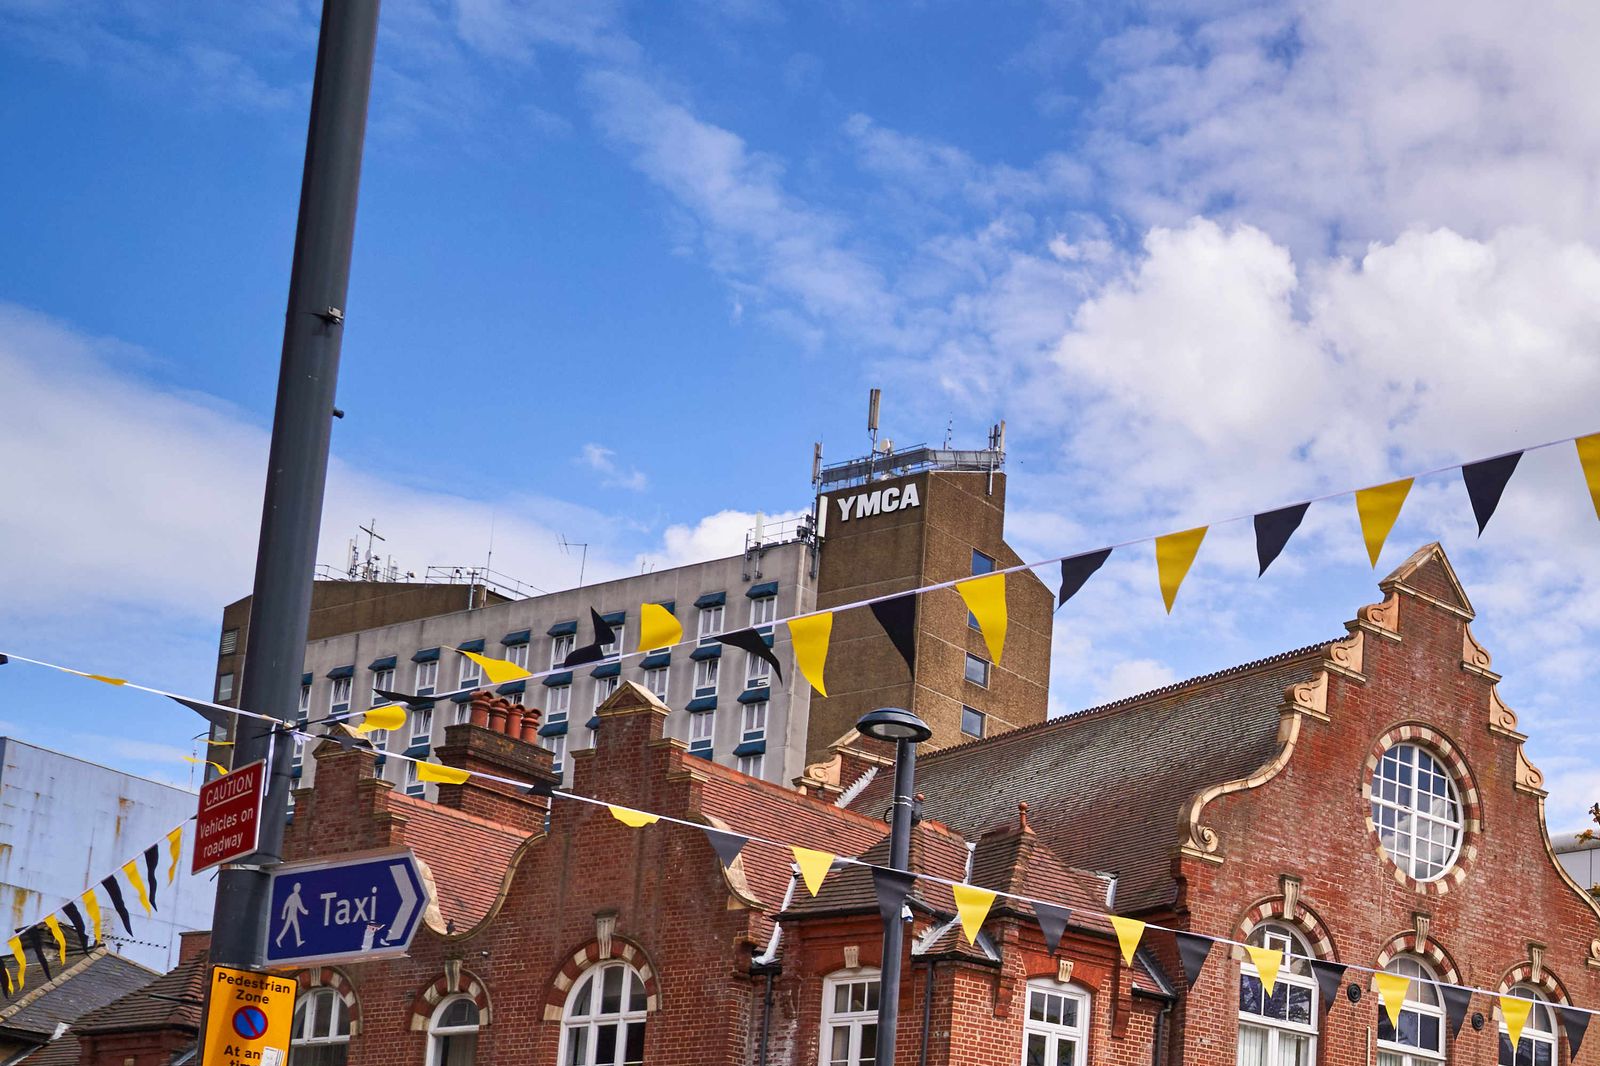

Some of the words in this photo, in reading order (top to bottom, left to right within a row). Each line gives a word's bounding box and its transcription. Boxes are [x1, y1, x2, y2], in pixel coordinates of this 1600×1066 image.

[837, 483, 920, 522] YMCA
[206, 773, 253, 806] CAUTION
[200, 813, 238, 839] Vehicles
[240, 806, 254, 823] on
[203, 832, 244, 858] roadway
[320, 886, 378, 927] Taxi
[218, 972, 290, 994] Pedestrian
[236, 989, 270, 1004] Zone
[224, 1045, 240, 1057] At
[244, 1050, 262, 1060] an
